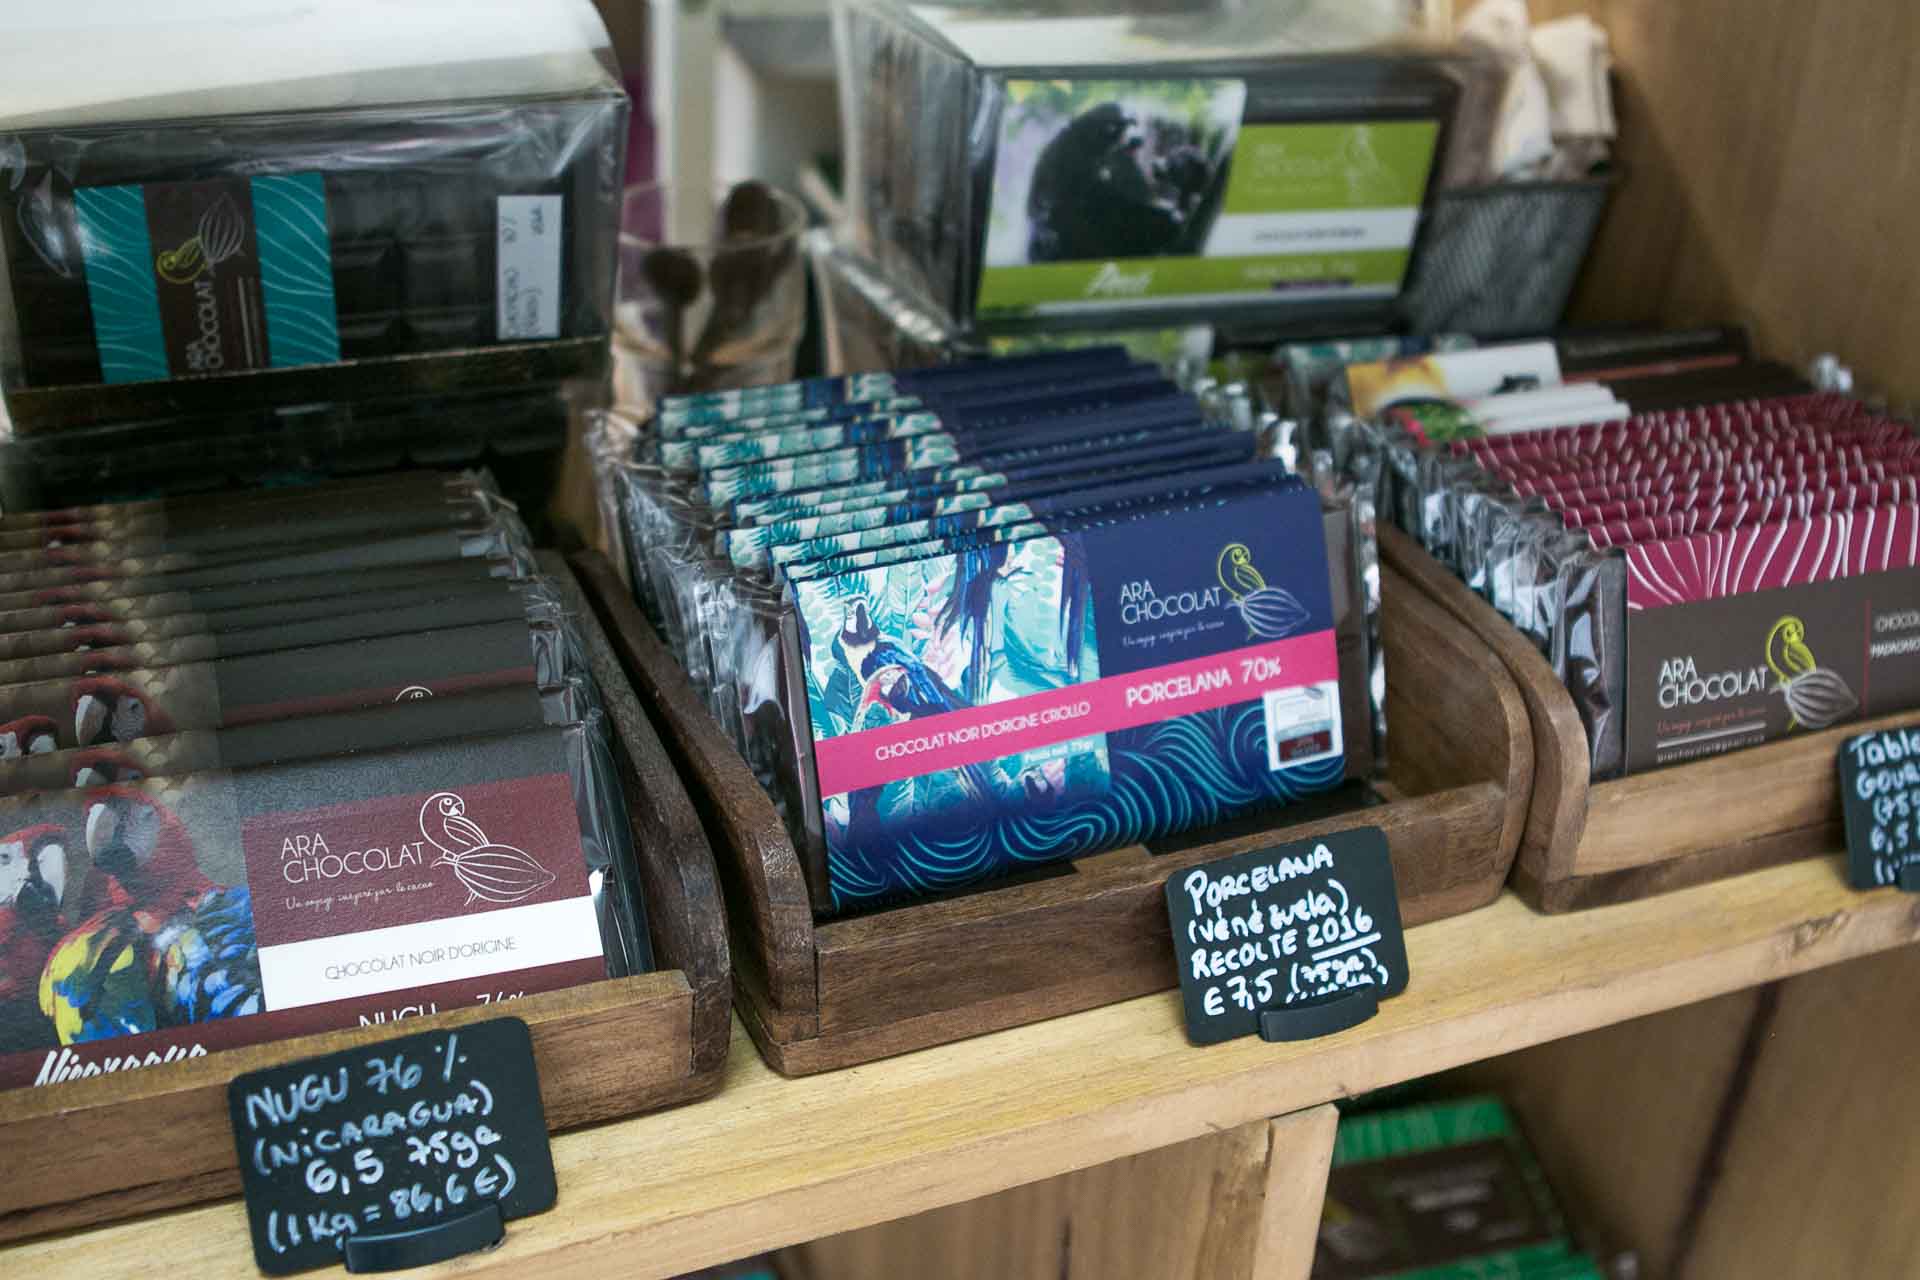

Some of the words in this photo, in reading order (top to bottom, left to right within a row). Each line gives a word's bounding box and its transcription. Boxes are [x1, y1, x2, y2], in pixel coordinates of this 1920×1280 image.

[1120, 580, 1156, 605] ARA
[1121, 586, 1222, 625] CHOCOLAT
[1126, 668, 1233, 708] PORCELANA
[1240, 656, 1282, 684] 70%
[1659, 656, 1698, 686] ARA
[1659, 667, 1768, 709] CHOCOLAT
[875, 733, 946, 761] CHOCOLAT
[949, 724, 980, 745] NOIR
[1040, 701, 1092, 724] CRIOLLO
[281, 833, 330, 860] ARA
[283, 842, 424, 884] CHOCOLAT
[1184, 843, 1334, 916] PORCELANA
[324, 953, 406, 980] CHOCOLAT
[410, 947, 446, 967] NOIR
[449, 935, 518, 961] D'ORIGINE
[1191, 928, 1299, 980] RECOLTE
[1306, 905, 1374, 949] 2016
[245, 1066, 349, 1129] NUGU
[305, 1148, 385, 1195] 6,5
